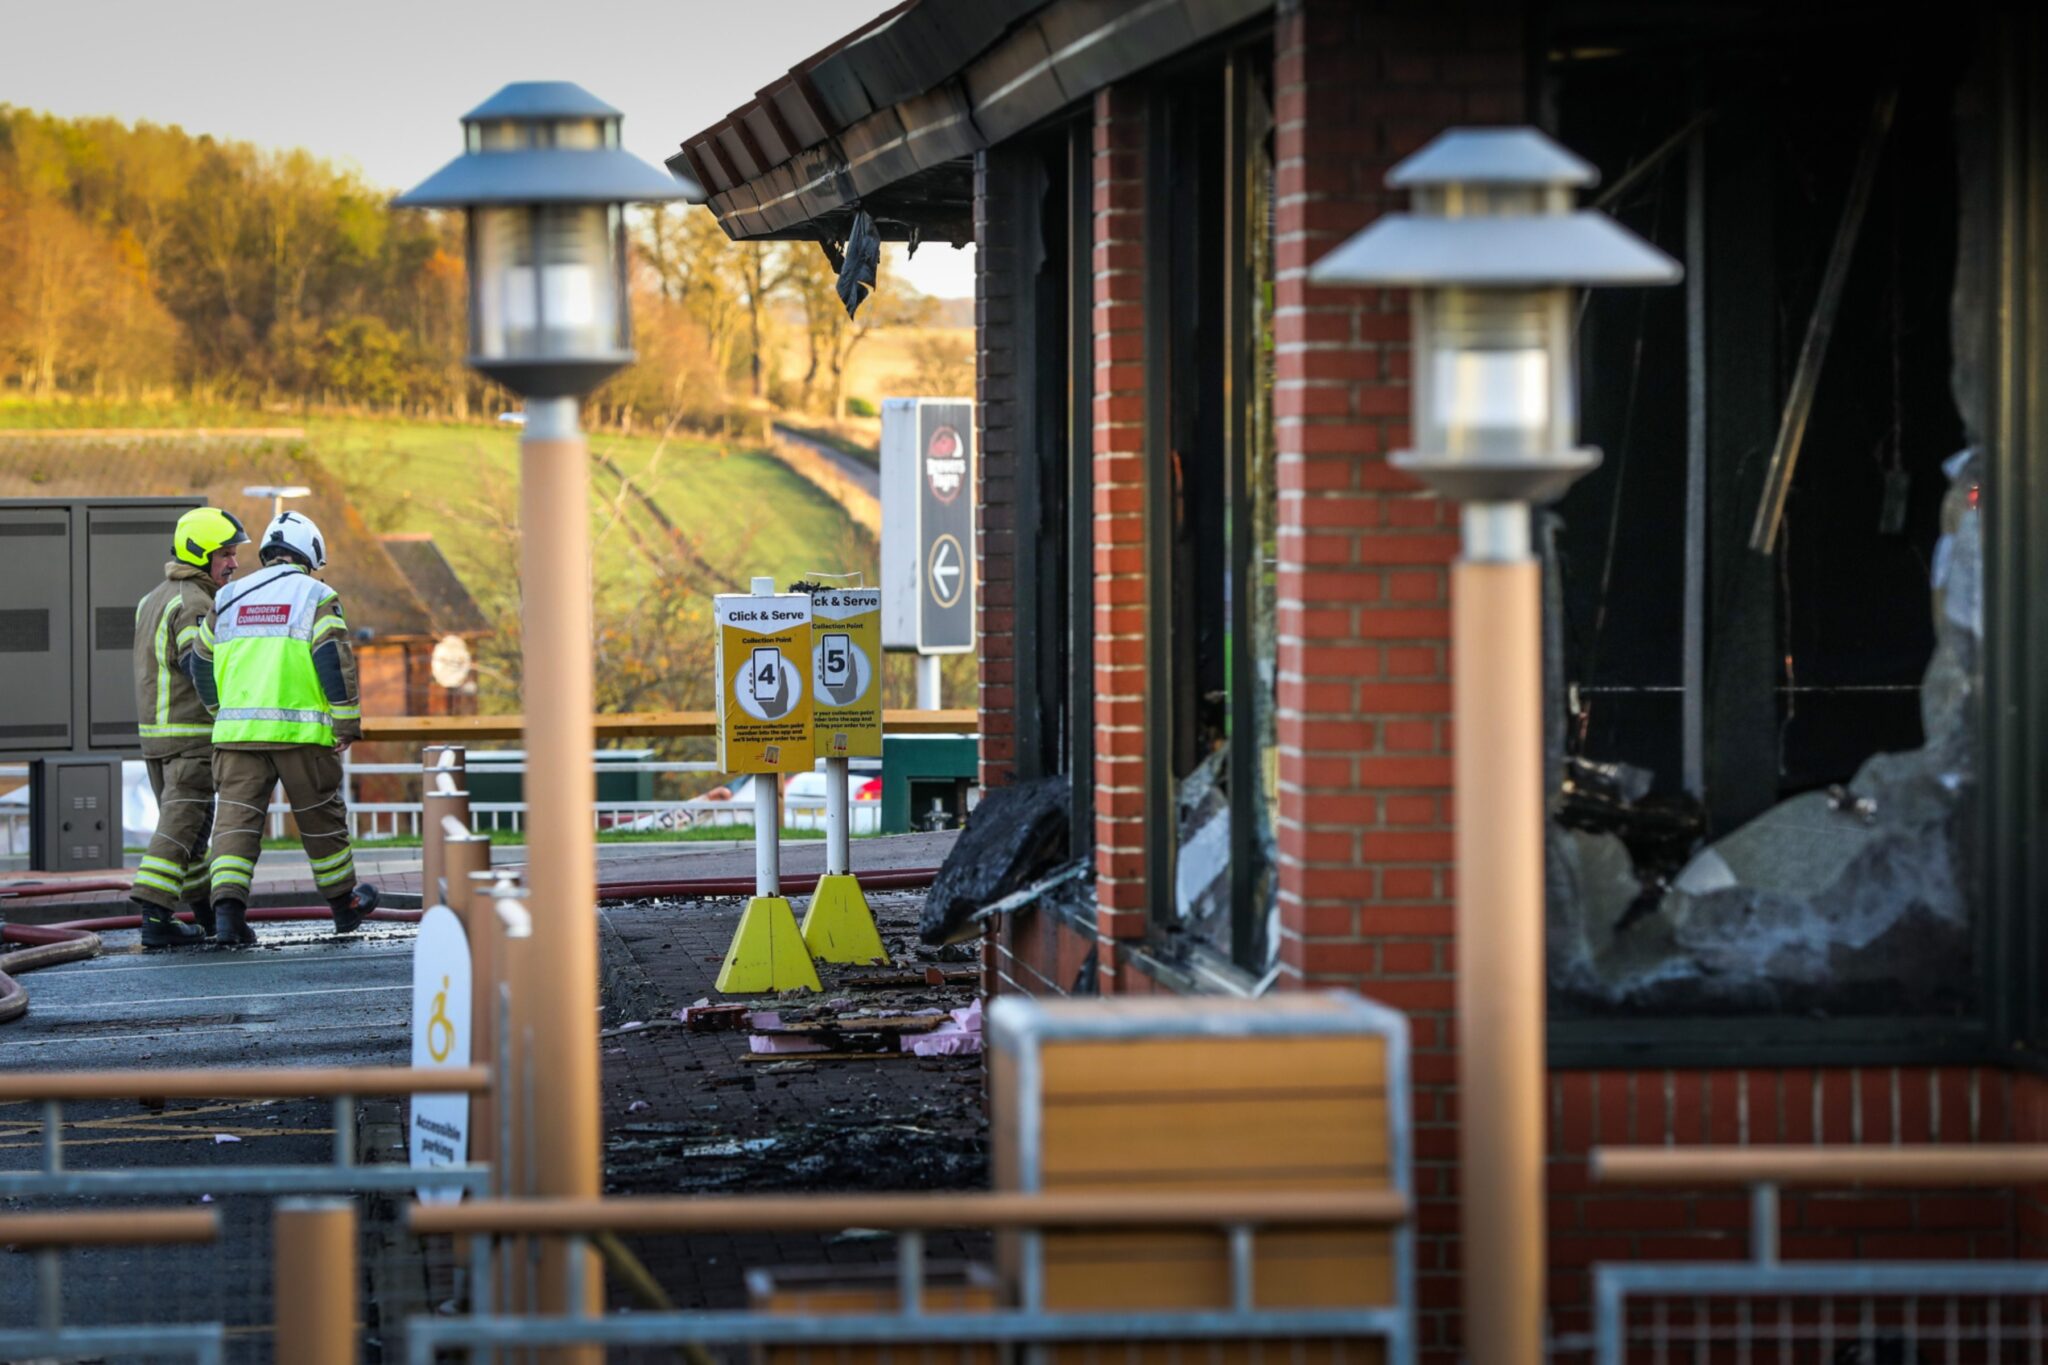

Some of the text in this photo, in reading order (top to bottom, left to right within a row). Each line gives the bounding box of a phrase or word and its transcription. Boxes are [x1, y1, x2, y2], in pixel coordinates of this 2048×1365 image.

[811, 596, 877, 606] ick & Serve
[246, 606, 282, 614] INCIDENT
[729, 610, 804, 622] Click & Serve
[238, 615, 286, 624] COMMANDER
[827, 650, 845, 673] 5
[758, 663, 775, 685] 4
[416, 1113, 461, 1143] Accessible
[421, 1138, 454, 1163] parking
